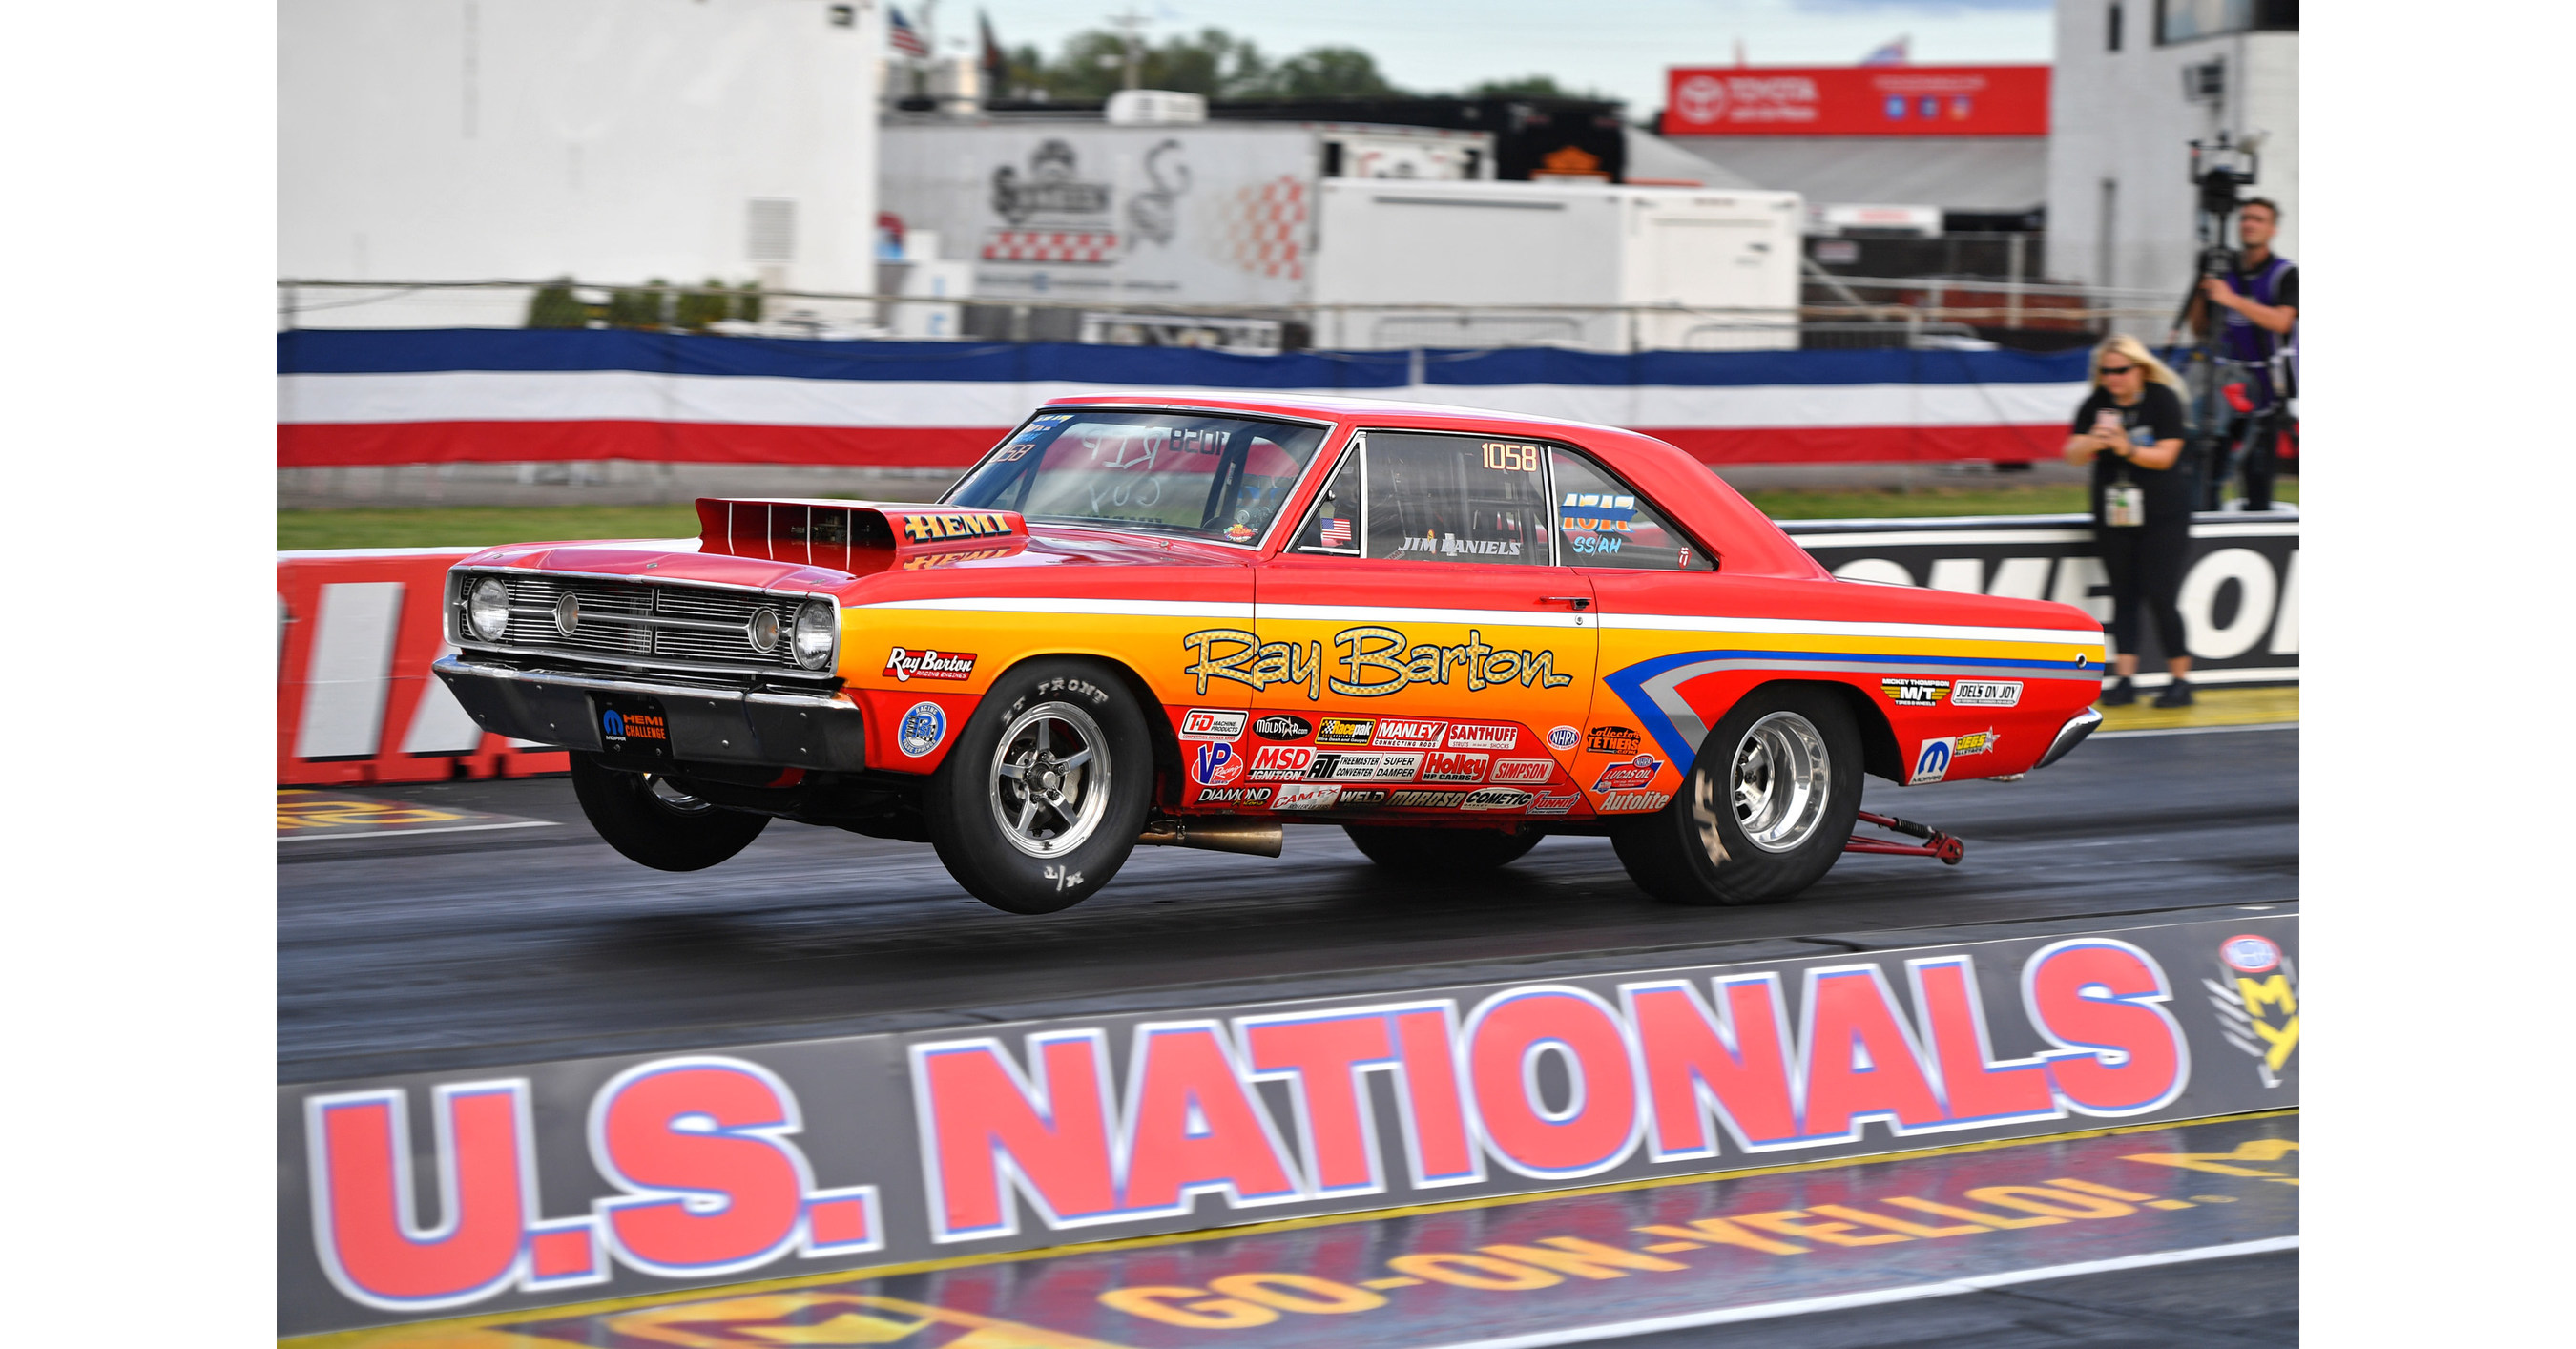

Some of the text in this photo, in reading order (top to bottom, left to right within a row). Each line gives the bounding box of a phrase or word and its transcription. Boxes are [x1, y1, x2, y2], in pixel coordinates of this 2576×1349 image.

[1482, 443, 1537, 472] 1058
[904, 514, 1012, 543] HEMI
[1398, 537, 1522, 555] JIM DANIELS
[1573, 534, 1622, 556] SS/AH
[886, 647, 973, 682] Ray Barton
[1184, 625, 1572, 701] Ray Barton
[940, 671, 967, 679] ENGINES
[1909, 678, 1950, 687] THOMPSON
[1037, 677, 1109, 704] FRONT
[1900, 686, 1936, 700] M/T
[1984, 685, 1997, 698] ON
[1998, 685, 2018, 699] JOY
[622, 713, 664, 727] HEMI
[624, 725, 667, 740] CHALLENGE
[1331, 720, 1373, 738] Racepak
[1378, 722, 1438, 739] MANLEY
[1450, 725, 1517, 742] SANTHUFF
[1550, 730, 1576, 745] NHRA
[1587, 737, 1639, 751] TETHERS
[1956, 733, 1987, 750] JEGS
[1197, 742, 1232, 785] VP
[1250, 748, 1312, 770] MSD
[1307, 754, 1342, 778] ATI
[1340, 757, 1381, 766] TREEMASTER
[1383, 757, 1415, 766] SUPER
[1424, 753, 1487, 781] Holley
[1213, 765, 1242, 779] Racing
[1250, 770, 1304, 781] IGNITION
[1336, 768, 1374, 777] CONVERTER
[1376, 768, 1415, 778] DAMPER
[1494, 762, 1549, 779] SIMPSON
[1604, 769, 1652, 780] LUCAS OIL
[1197, 787, 1272, 802] DIAMOND
[1273, 788, 1339, 809] CAM FX
[1340, 790, 1386, 802] WELD
[1385, 790, 1466, 808] MOROSO
[1465, 791, 1533, 806] COMETIC
[1530, 791, 1576, 810] SUMMIT
[1598, 790, 1670, 811] Autolite
[306, 937, 2191, 1311] U.S. NATIONALS
